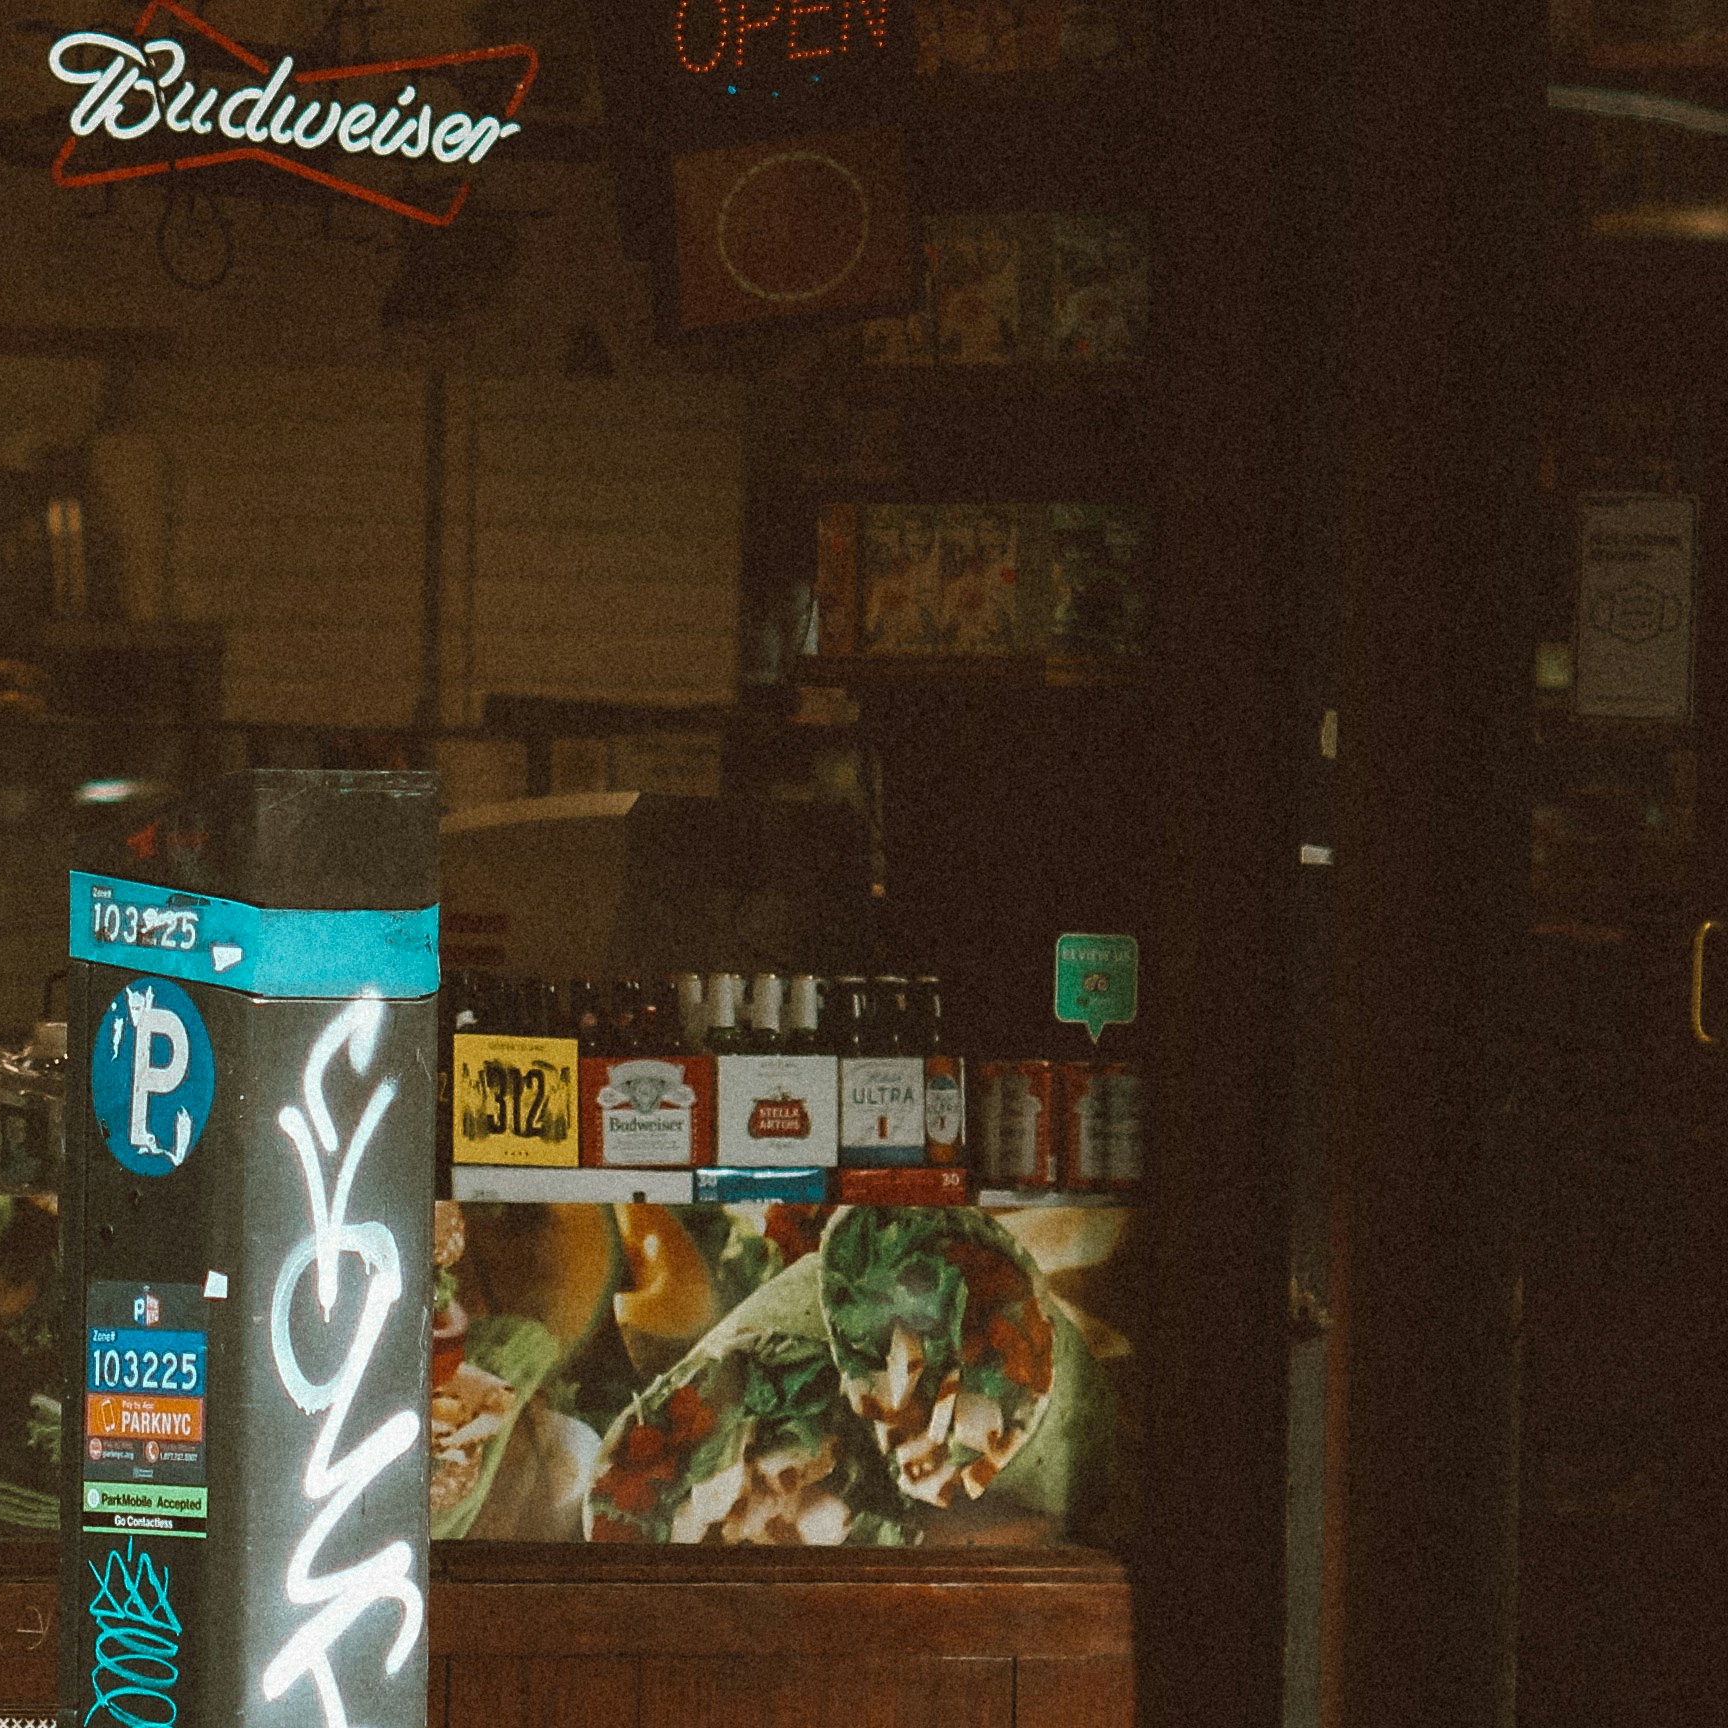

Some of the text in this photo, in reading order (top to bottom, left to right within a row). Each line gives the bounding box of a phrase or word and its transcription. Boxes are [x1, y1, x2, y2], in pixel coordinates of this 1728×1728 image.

[676, 0, 888, 72] OPEN
[48, 31, 521, 164] Budweiser
[483, 1060, 546, 1137] 312
[853, 1087, 914, 1104] ULTRA
[759, 1107, 800, 1119] STELLA
[609, 1117, 684, 1133] Budweiser
[942, 1172, 960, 1187] 30
[92, 1329, 116, 1342] Zone#
[93, 1349, 198, 1391] 103225
[121, 1411, 191, 1436] PARKNYC
[101, 1493, 202, 1512] ParkMobile Accepted
[114, 1515, 174, 1530] Go Contactless
